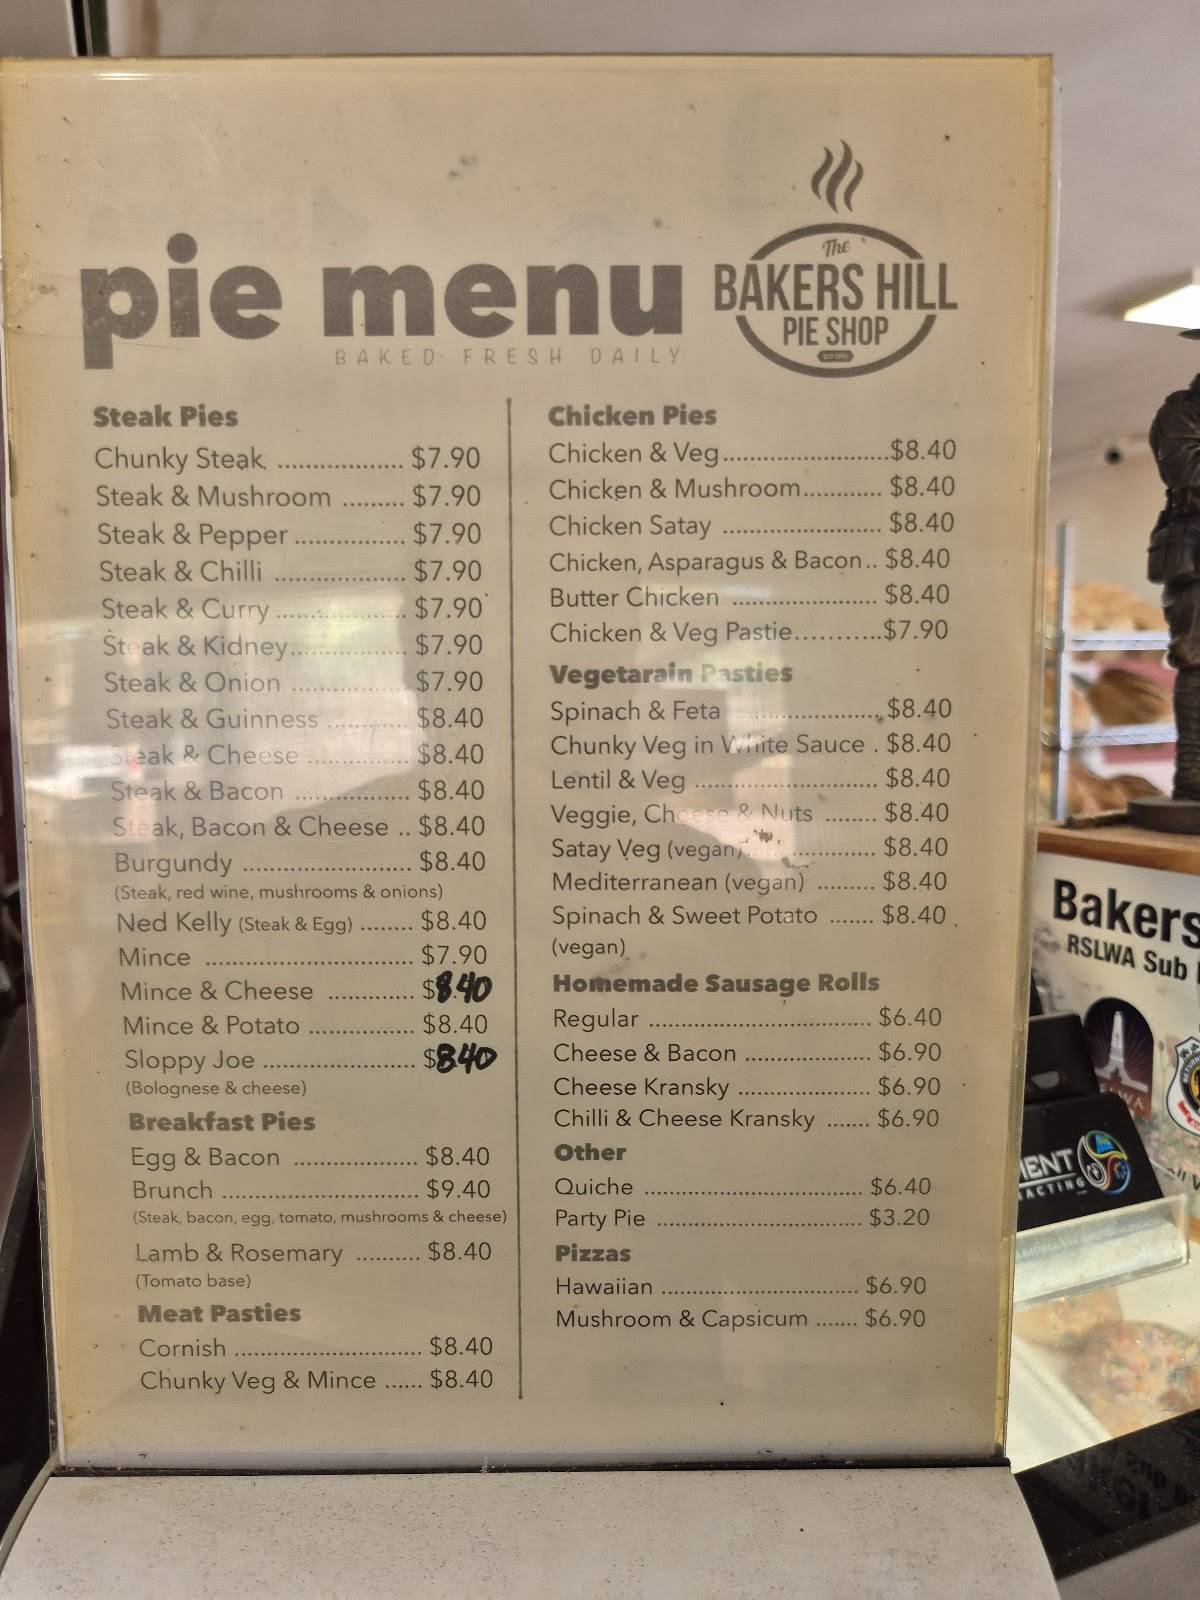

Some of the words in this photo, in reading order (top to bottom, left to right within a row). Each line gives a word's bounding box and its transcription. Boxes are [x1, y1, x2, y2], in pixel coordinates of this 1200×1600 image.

[823, 238, 849, 257] The
[714, 263, 864, 311] BAKERS
[877, 263, 958, 310] HILL
[81, 232, 282, 370] pie
[323, 263, 683, 339] menu
[784, 317, 818, 346] PIE
[825, 316, 888, 345] SHOP
[335, 350, 436, 366] BAKED
[464, 348, 563, 365] FRESH
[590, 347, 683, 365] DAILY
[94, 405, 173, 427] Steak
[180, 405, 238, 427] Pies
[548, 405, 655, 426] Chicken
[663, 404, 717, 426] Pies
[95, 448, 188, 474] Chunky
[196, 447, 266, 469] Steak
[412, 446, 480, 470] $7.90
[549, 442, 642, 463] Chicken
[674, 441, 719, 467] Veg
[891, 439, 956, 462] $8.40
[97, 485, 163, 507] Steak
[199, 485, 331, 507] Mushroom
[549, 478, 642, 499] Chicken
[675, 478, 800, 498] Mushroom
[98, 523, 165, 544] Steak
[200, 524, 288, 550] Pepper
[414, 522, 481, 545] $7.90
[549, 514, 642, 536] Chicken
[650, 514, 711, 540] Satay
[890, 511, 954, 534] $8.40
[100, 561, 166, 582] Steak
[201, 560, 262, 581] Chilli
[549, 552, 642, 575] Chicken,
[648, 551, 764, 575] Asparagus
[795, 550, 862, 569] Bacon
[550, 588, 619, 607] Butter
[626, 586, 719, 607] Chicken
[885, 584, 950, 606] $8.40
[102, 598, 168, 619] Steak
[202, 598, 269, 624] Curry
[415, 596, 482, 620] $7.90
[550, 622, 642, 643] Chicken
[673, 621, 718, 647] Veg
[726, 621, 792, 641] Pastie
[103, 634, 169, 656] Steak
[204, 634, 288, 661] Kidney
[105, 672, 171, 693] Steak
[205, 672, 280, 693] Onion
[417, 670, 483, 693] $7.90
[550, 663, 692, 689] Vegetarain
[106, 708, 172, 729] Steak
[207, 708, 318, 729] Guinness
[551, 701, 640, 726] Spinach
[673, 701, 720, 720] Feta
[887, 697, 952, 720] $8.40
[208, 744, 298, 765] Cheese
[418, 743, 484, 766] $8.40
[551, 735, 637, 760] Chunky
[642, 735, 686, 759] Veg
[695, 736, 713, 753] in
[722, 734, 788, 753] White
[796, 734, 864, 753] Sauce
[112, 781, 176, 800] Steak
[211, 781, 283, 800] Bacon
[552, 770, 611, 790] Lentil
[641, 770, 685, 794] Veg
[886, 767, 950, 790] $8.40
[113, 817, 183, 838] Steak,
[192, 817, 265, 836] Bacon
[300, 816, 389, 836] Cheese
[419, 815, 485, 837] $8.40
[551, 805, 637, 829] Veggie,
[762, 803, 813, 823] Nuts
[552, 839, 611, 863] Satay
[618, 839, 660, 863] Veg
[668, 840, 742, 861] (vegan)
[884, 837, 948, 859] $8.40
[116, 852, 232, 877] Burgundy
[115, 886, 171, 902] (Steak,
[177, 886, 205, 900] red
[210, 888, 254, 902] wine,
[259, 885, 358, 899] mushrooms
[381, 884, 443, 900] onions)
[553, 872, 717, 892] Mediterranean
[725, 873, 804, 895] (vegan)
[118, 912, 167, 932] Ned
[177, 912, 231, 937] Kelly
[239, 917, 290, 932] (Steak
[313, 917, 352, 934] Egg)
[421, 910, 487, 932] $8.40
[553, 906, 640, 930] Spinach
[672, 906, 741, 925] Sweet
[748, 905, 818, 924] Potato
[882, 905, 946, 926] $8.40
[1053, 878, 1200, 949] Bakers
[119, 948, 191, 967] Mince
[552, 938, 626, 959] (vegan)
[1067, 933, 1135, 969] RSLWA
[1143, 949, 1188, 981] Sub
[121, 981, 192, 1001] Mince
[225, 980, 313, 1001] Cheese
[553, 973, 698, 993] Homemade
[705, 973, 810, 997] Sausage
[818, 972, 880, 992] Rolls
[123, 1016, 193, 1035] Mince
[227, 1015, 300, 1034] Potato
[424, 1014, 488, 1036] $8.40
[554, 1009, 639, 1033] Regular
[125, 1049, 206, 1074] Sloppy
[213, 1049, 255, 1069] Joe
[554, 1043, 636, 1062] Cheese
[668, 1043, 736, 1062] Bacon
[878, 1042, 941, 1063] $6.90
[126, 1081, 219, 1098] (Bolognese
[242, 1081, 307, 1097] cheese)
[554, 1077, 636, 1096] Cheese
[645, 1077, 730, 1100] Kransky
[129, 1112, 255, 1131] Breakfast
[262, 1112, 315, 1131] Pies
[554, 1109, 608, 1128] Chilli
[639, 1108, 722, 1127] Cheese
[730, 1108, 815, 1132] Kransky
[878, 1108, 940, 1129] $6.90
[131, 1148, 176, 1170] Egg
[210, 1148, 280, 1166] Bacon
[555, 1143, 626, 1161] Other
[133, 1180, 212, 1199] Brunch
[427, 1178, 490, 1200] $9.40
[555, 1177, 633, 1197] Quiche
[133, 1211, 183, 1225] (Steak,
[187, 1211, 238, 1224] bacon,
[242, 1213, 275, 1226] egg,
[280, 1212, 336, 1224] tomato,
[342, 1210, 428, 1223] mushrooms
[448, 1210, 507, 1224] cheese)
[555, 1209, 606, 1231] Party
[614, 1208, 645, 1228] Pie
[870, 1208, 930, 1228] $3.20
[136, 1243, 198, 1262] Lamb
[231, 1243, 343, 1266] Rosemary
[556, 1243, 631, 1262] Pizzas
[136, 1274, 201, 1289] (Tomato
[207, 1274, 251, 1289] base)
[556, 1276, 652, 1295] Hawaiian
[138, 1304, 203, 1322] Meat
[211, 1303, 301, 1322] Pasties
[556, 1309, 671, 1328] Mushroom
[702, 1308, 808, 1332] Capsicum
[865, 1307, 926, 1328] $6.90
[140, 1338, 226, 1357] Cornish
[430, 1336, 493, 1357] $8.40
[141, 1371, 225, 1394] Chunky
[232, 1371, 275, 1394] Veg
[308, 1370, 376, 1388] Mince
